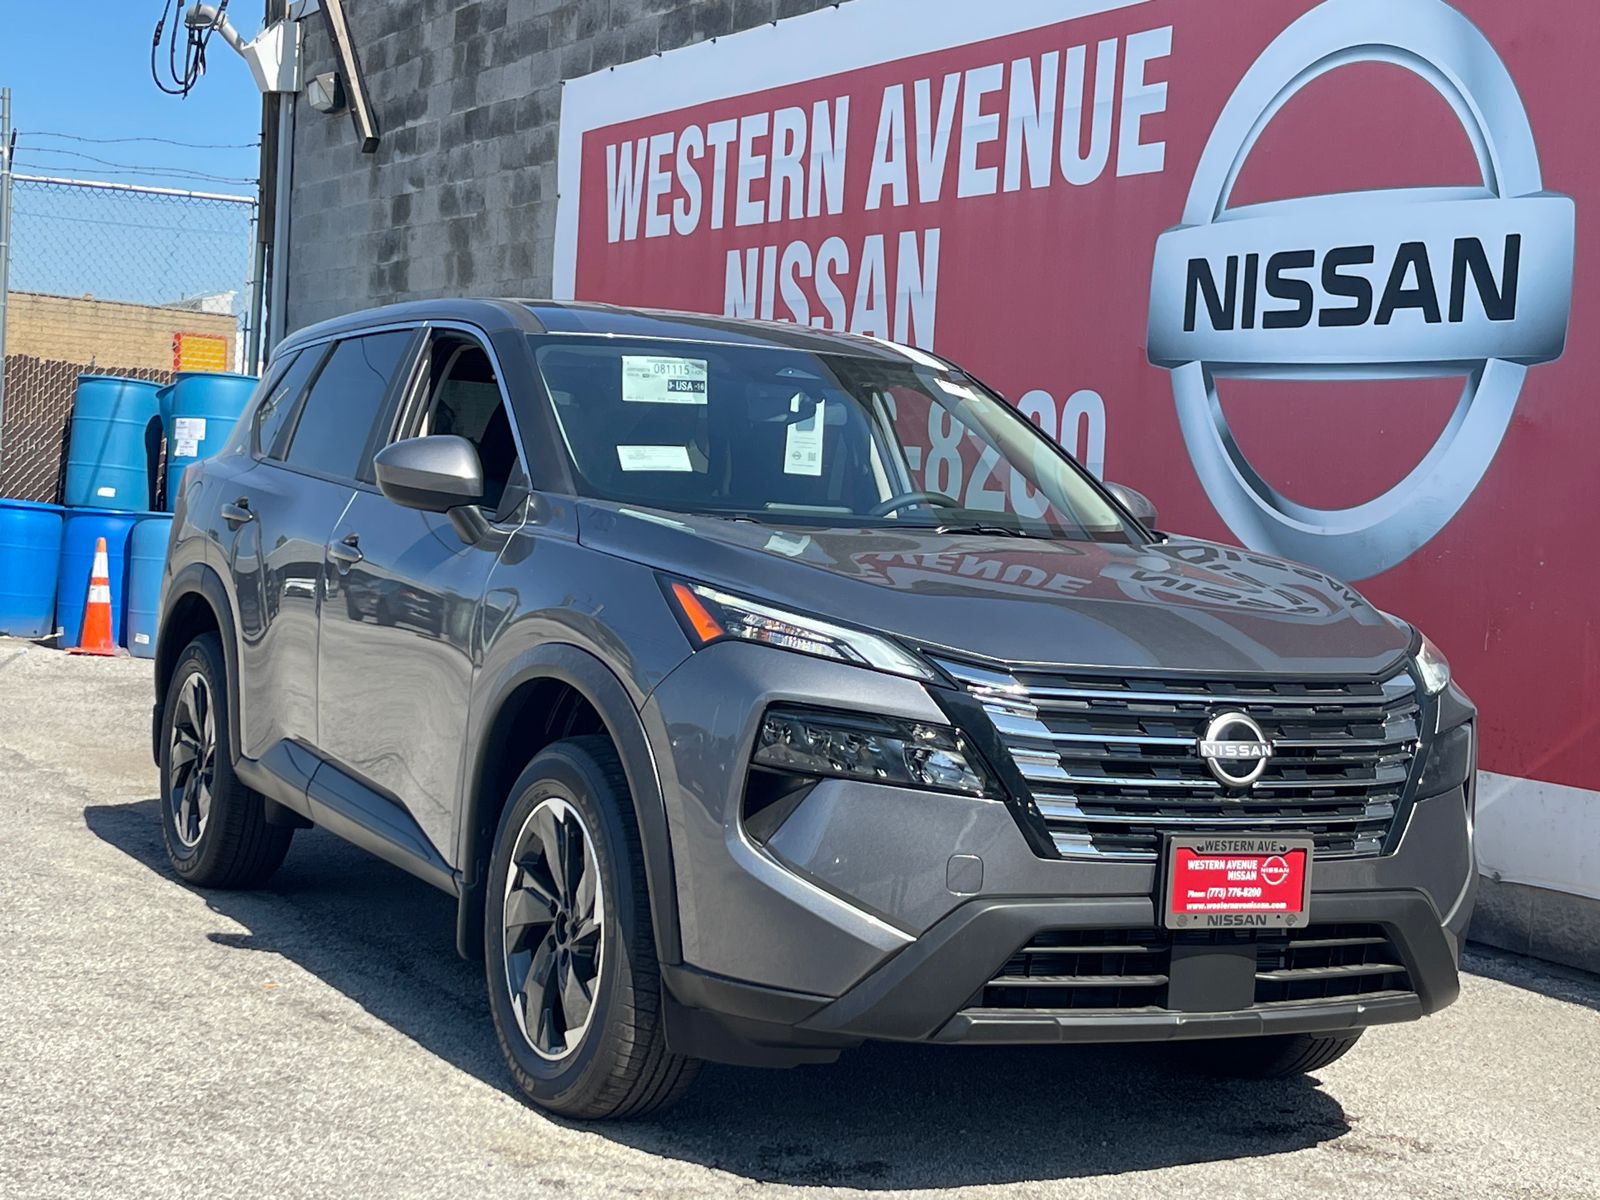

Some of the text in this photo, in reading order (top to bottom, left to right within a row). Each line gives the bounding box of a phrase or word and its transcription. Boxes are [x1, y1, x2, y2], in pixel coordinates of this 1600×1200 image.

[605, 24, 1174, 243] WESTERN AVENUE
[1183, 233, 1521, 332] NISSAN
[724, 228, 940, 352] NISSAN
[654, 363, 690, 375] 081115
[676, 381, 693, 391] USA
[1202, 744, 1271, 756] NISSAN
[1204, 840, 1277, 851] WESTERN AVE
[1187, 860, 1258, 870] WESTERN AVENUE
[1227, 871, 1258, 880] NISSAN
[1207, 887, 1226, 899] (773)
[1228, 887, 1262, 897] 776-8200
[1207, 914, 1267, 926] NISSAN
